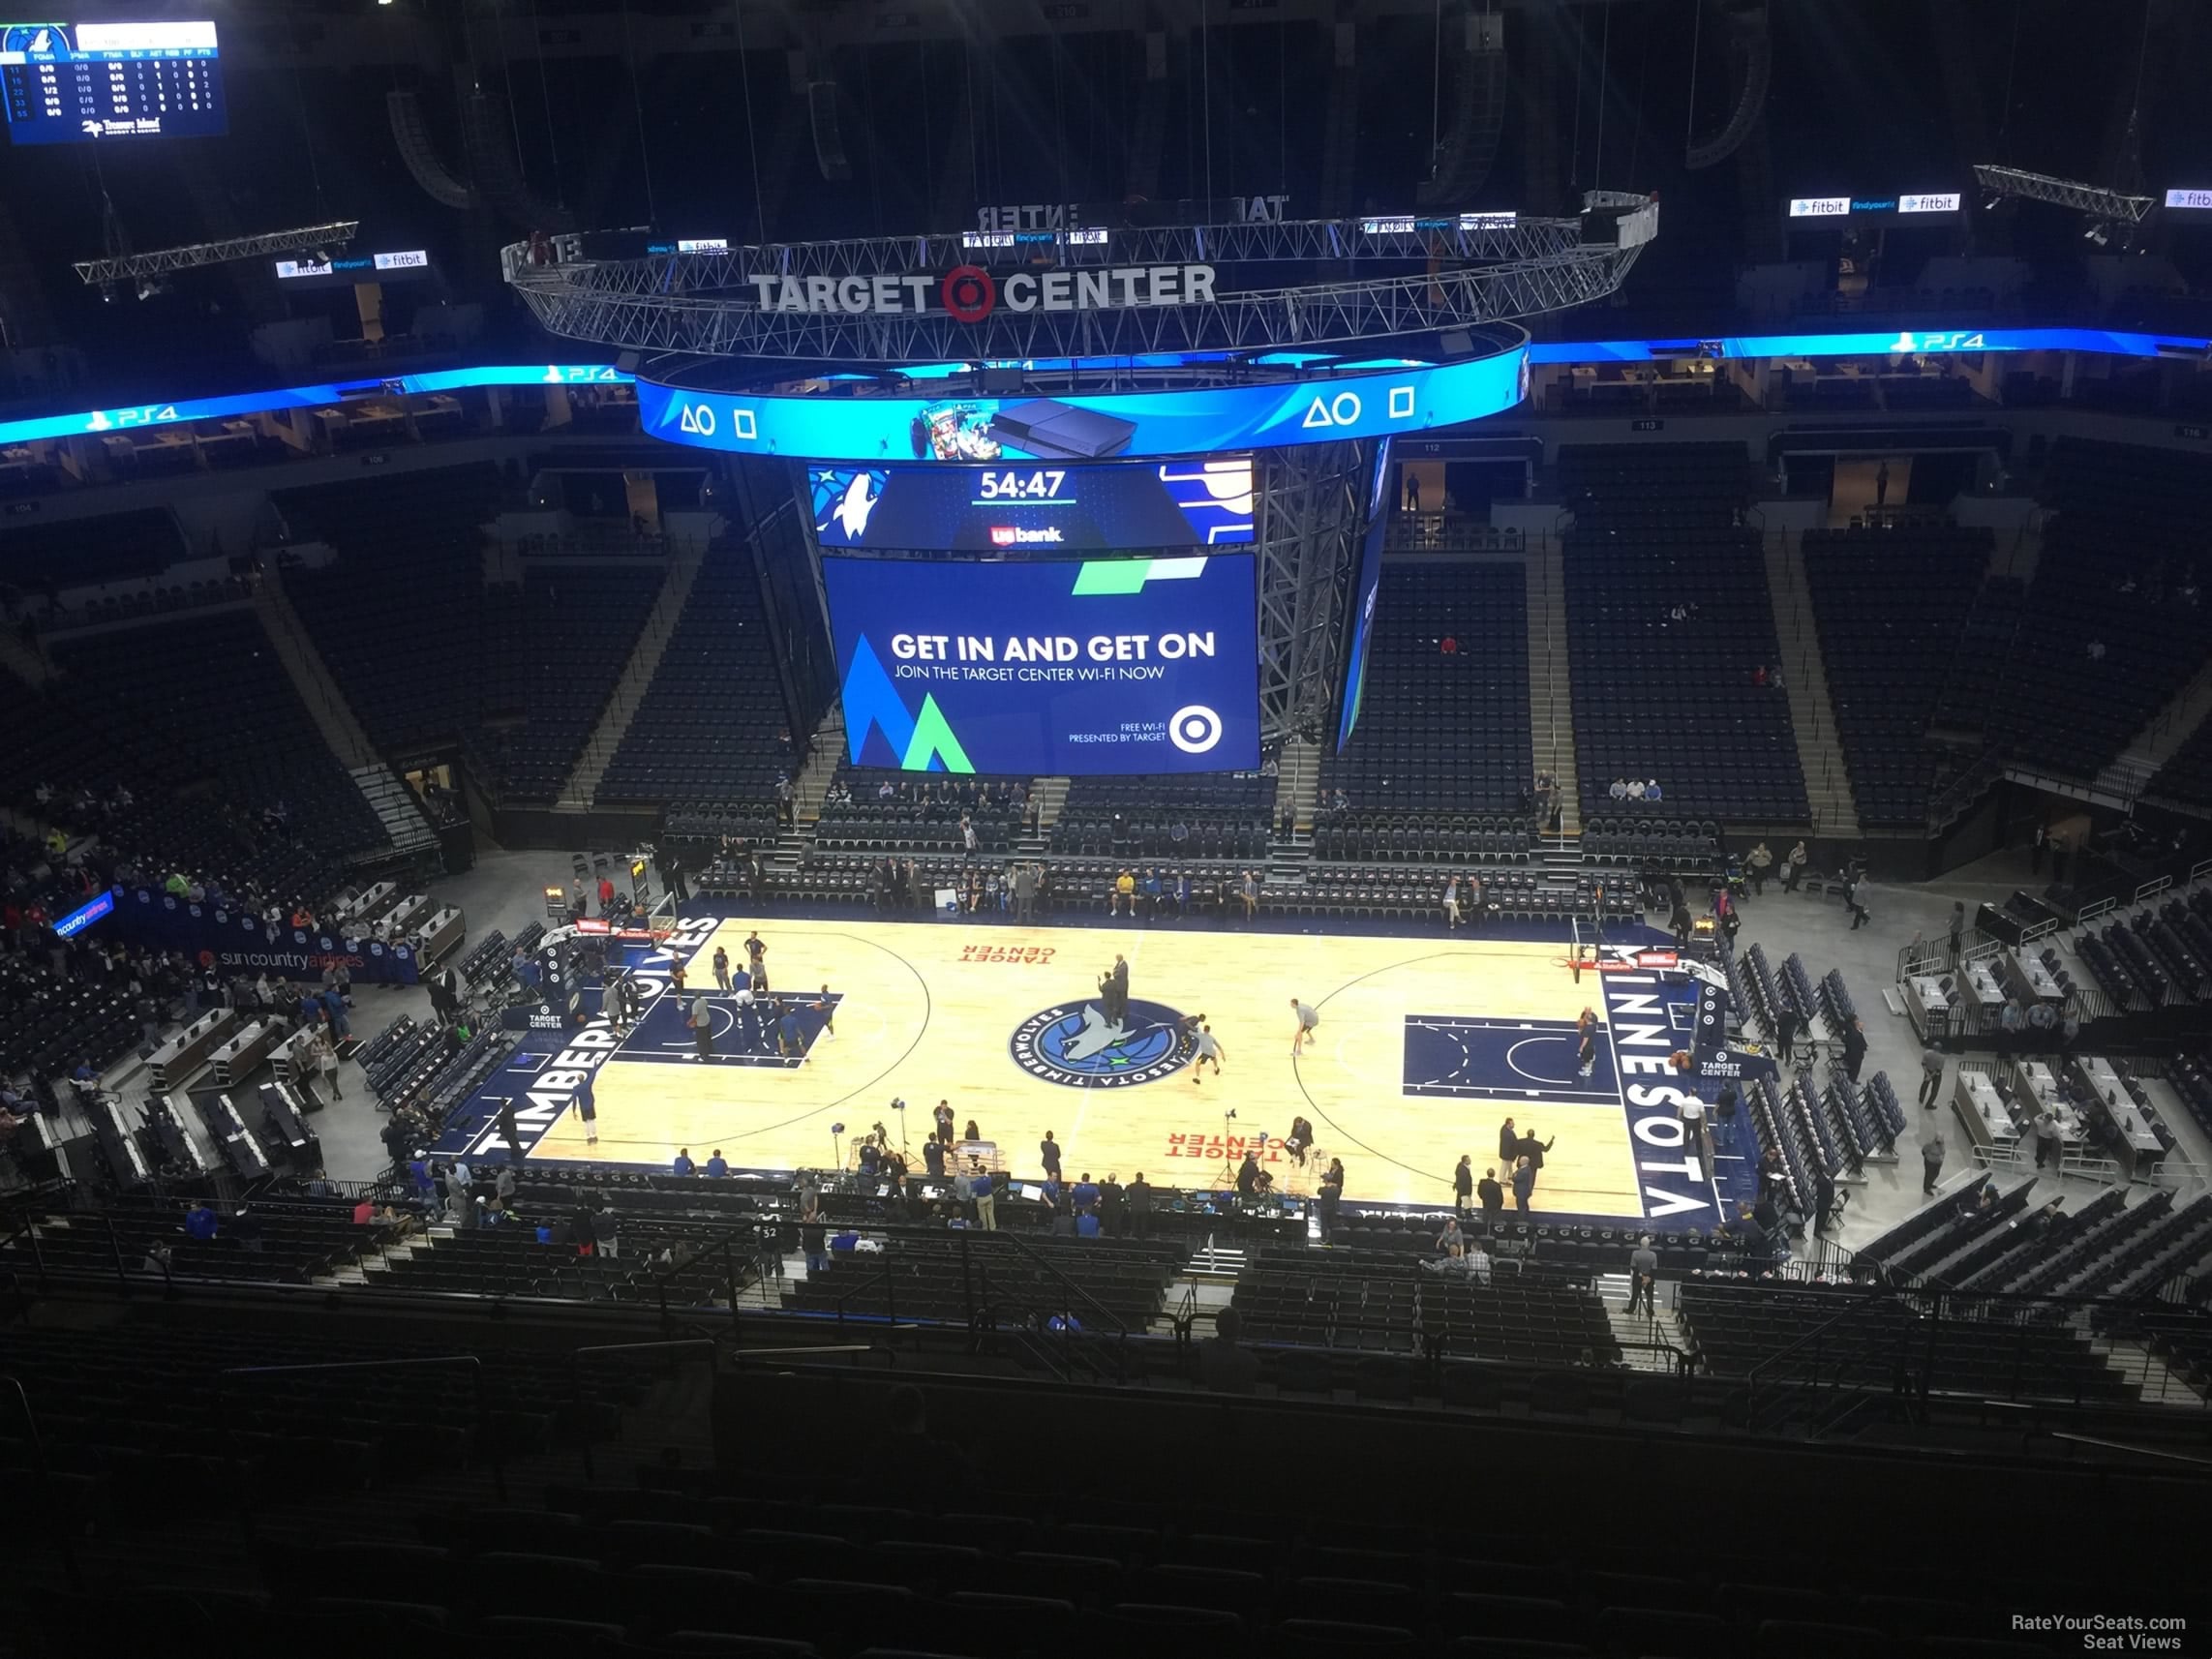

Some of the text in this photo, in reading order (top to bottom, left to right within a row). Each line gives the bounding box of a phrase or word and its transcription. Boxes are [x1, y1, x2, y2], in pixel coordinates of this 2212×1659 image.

[107, 62, 123, 71] 0/0
[1920, 196, 1952, 210] fitbit
[2188, 193, 2212, 206] fitb
[1811, 200, 1843, 213] fitbit
[393, 254, 421, 267] fitbit
[749, 264, 1216, 314] TARGET CENTER
[1924, 333, 1985, 349] PS4
[568, 368, 619, 380] PS4
[118, 406, 178, 426] PS4
[1425, 443, 1440, 452] 112
[980, 470, 1066, 498] 54:47
[891, 631, 1215, 662] GET IN AND GET ON
[894, 664, 1166, 681] JOIN THE TARGET CENTER WI-FI NOW
[1120, 721, 1166, 733] FREE WI-FI
[1069, 731, 1167, 743] PRESENTED BY TARGET
[962, 945, 1056, 956] CENTER
[957, 953, 1051, 965] TARGET
[529, 1013, 562, 1023] TARGET
[1016, 1008, 1084, 1086] TIMBERWOLVES
[1701, 1061, 1742, 1071] TARGET
[1700, 1069, 1741, 1077] CENTER
[1168, 1132, 1286, 1150] CENTER
[763, 1227, 776, 1238] 32
[1494, 1224, 1505, 1233] G
[1517, 1225, 1529, 1234] G
[1537, 1227, 1549, 1236] G
[1580, 1229, 1591, 1238] G
[1601, 1230, 1613, 1240] G
[1623, 1232, 1635, 1241] G
[1667, 1235, 1679, 1244] G
[1689, 1237, 1701, 1246] G
